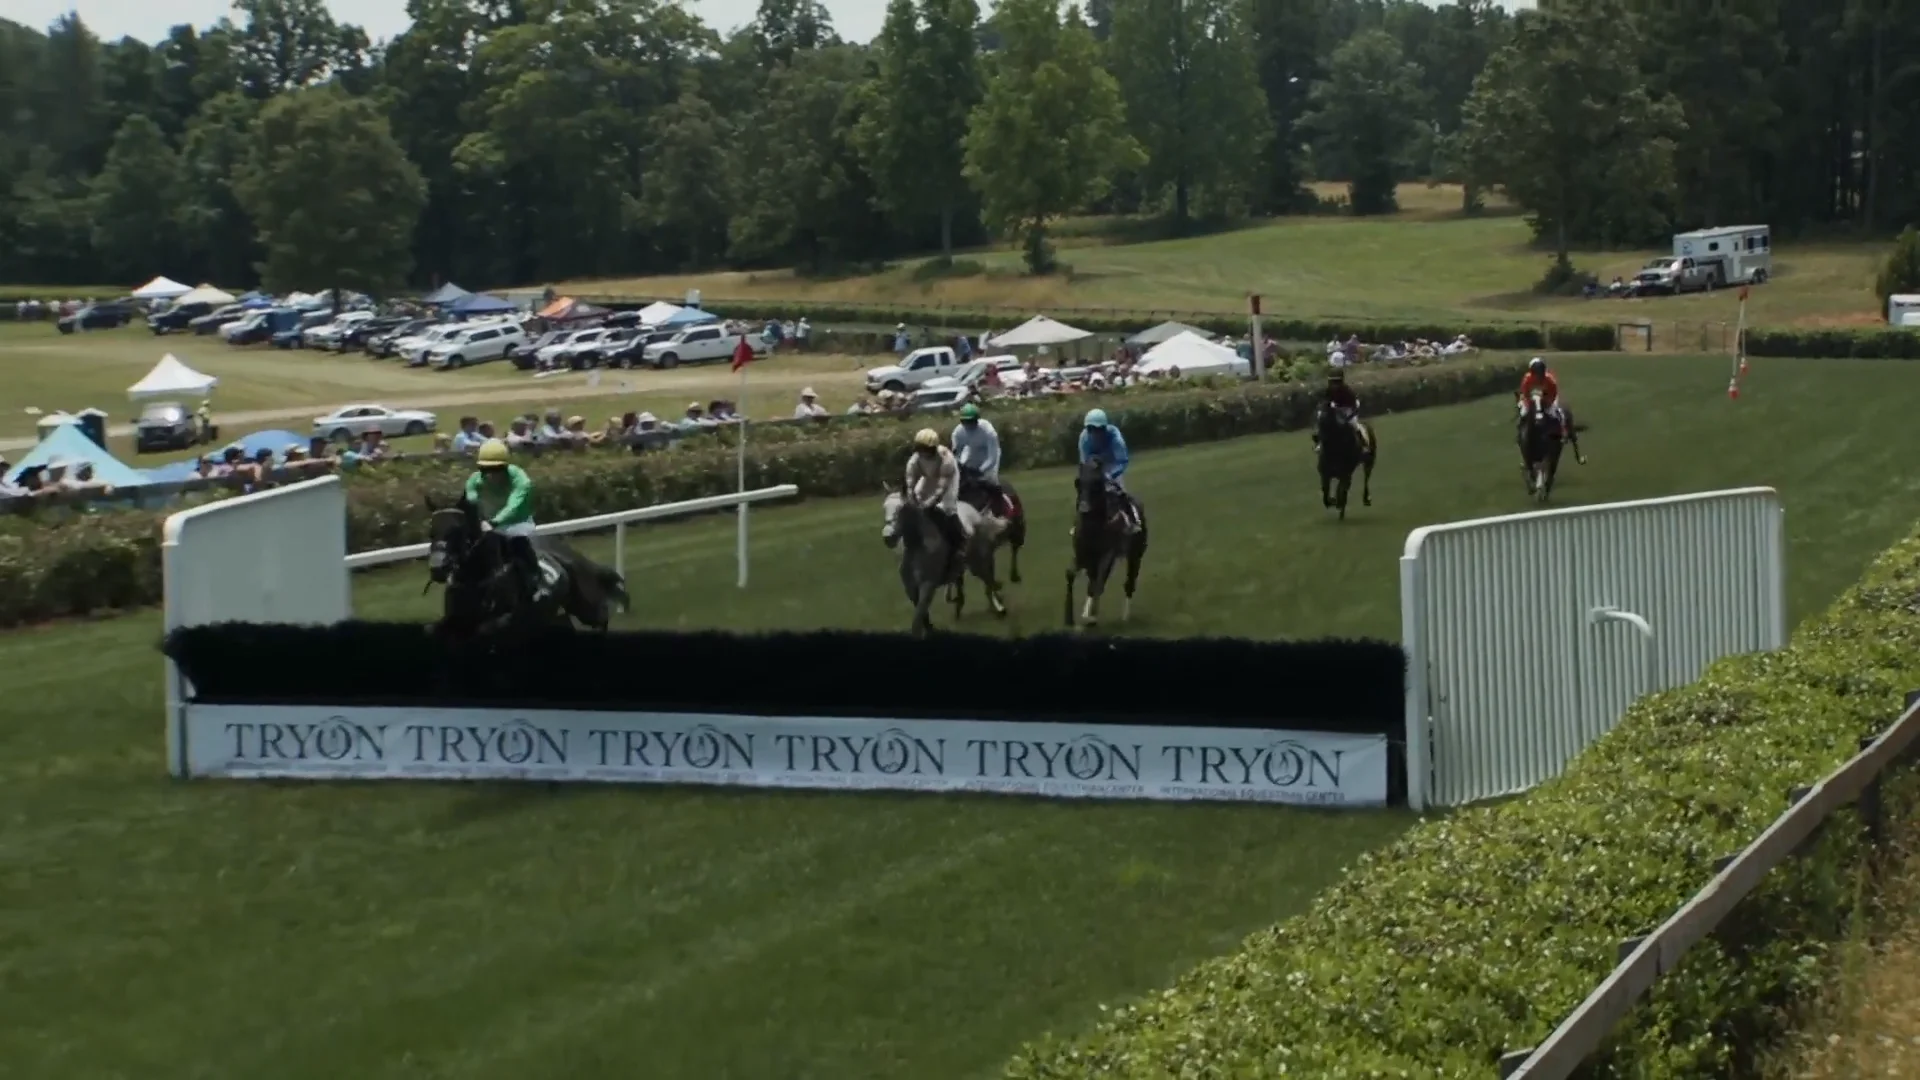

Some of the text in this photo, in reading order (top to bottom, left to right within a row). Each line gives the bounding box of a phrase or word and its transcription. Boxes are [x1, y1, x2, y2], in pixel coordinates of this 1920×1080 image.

[225, 723, 1345, 788] TRYON TRYON TRYON TRYON TRYON TRYON
